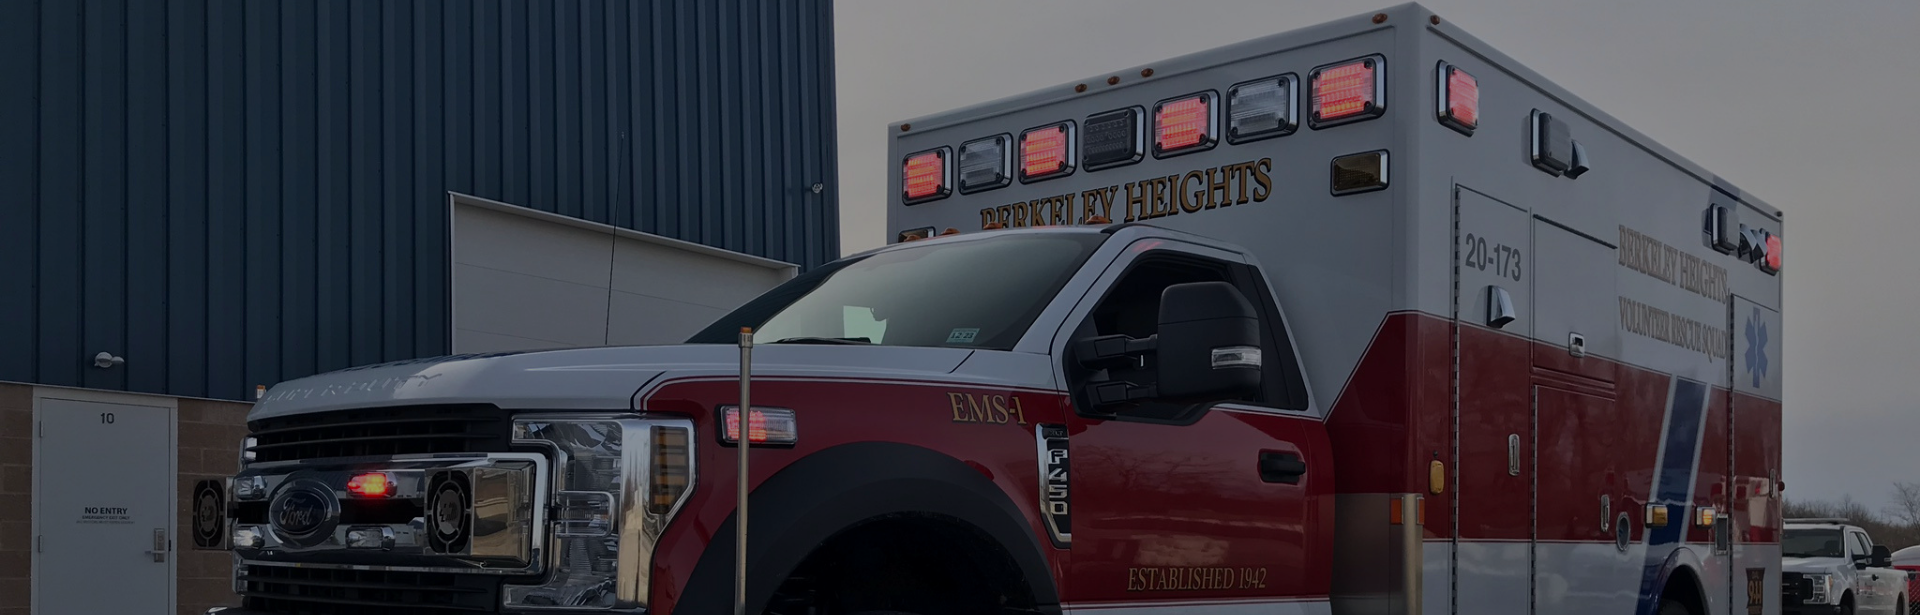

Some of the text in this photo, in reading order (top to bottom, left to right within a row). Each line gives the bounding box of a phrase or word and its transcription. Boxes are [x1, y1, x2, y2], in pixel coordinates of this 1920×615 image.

[1123, 158, 1272, 223] HEIGHTS
[1465, 233, 1522, 282] 20-173
[1618, 224, 1729, 305] BERKELEY HEIGHTS
[1618, 296, 1726, 363] VOLUNTEER RESCUE SQUAD
[100, 412, 115, 424] 10
[947, 391, 1027, 425] EMS-1
[1048, 448, 1069, 516] F450
[100, 507, 128, 515] ENTRY
[279, 497, 313, 526] Ford
[1127, 567, 1267, 591] ESTABLISHED 1942
